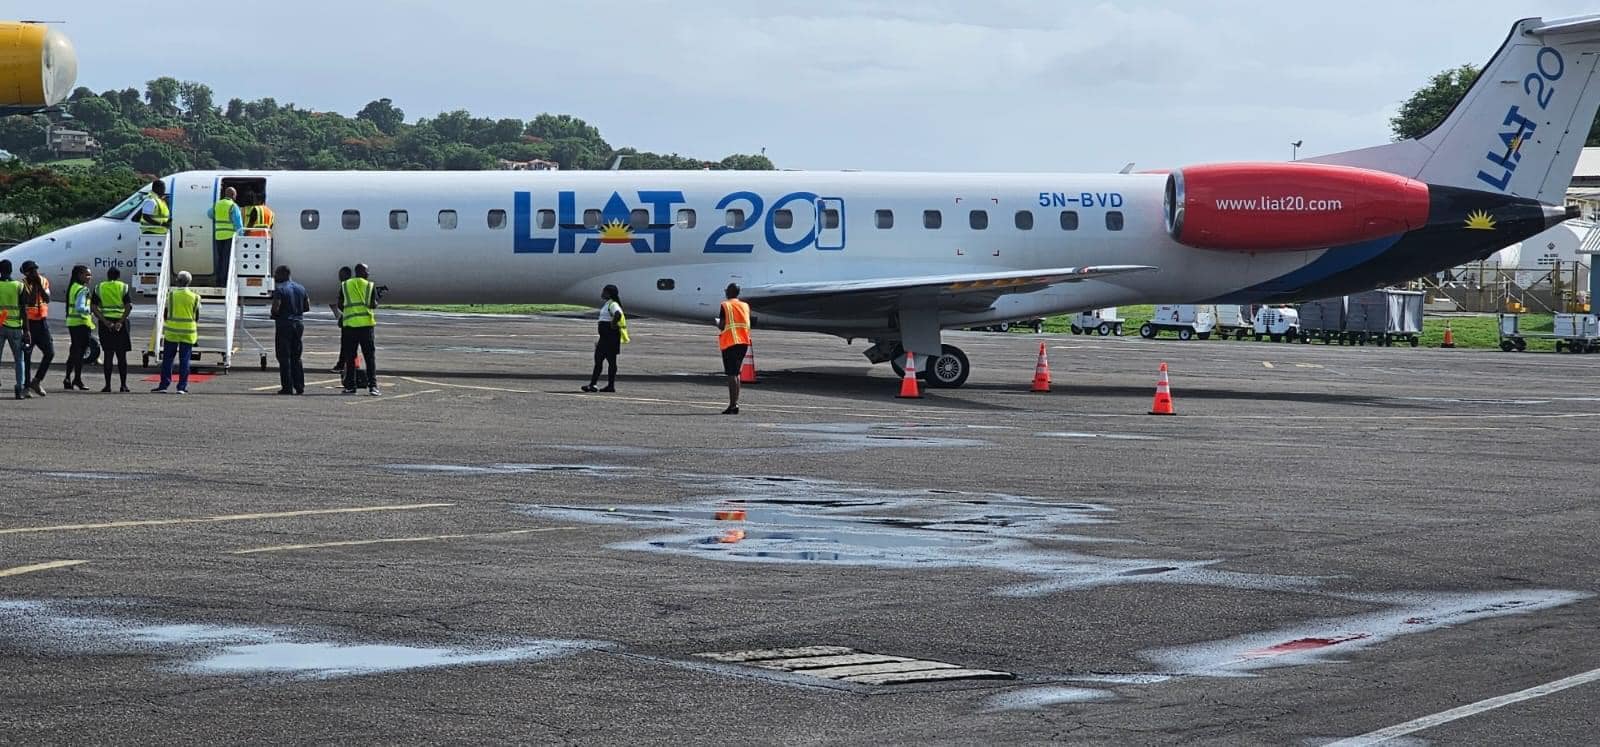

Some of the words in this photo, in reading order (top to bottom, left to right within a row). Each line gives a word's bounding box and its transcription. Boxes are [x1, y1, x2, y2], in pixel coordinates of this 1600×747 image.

[1476, 104, 1537, 191] LIAT
[1524, 46, 1564, 110] 20
[1039, 192, 1123, 207] 5N-BVD
[1215, 196, 1342, 211] www.liat20.com
[513, 190, 686, 254] LIAT
[703, 191, 826, 254] 20
[94, 257, 124, 268] Pride
[126, 257, 138, 268] of
